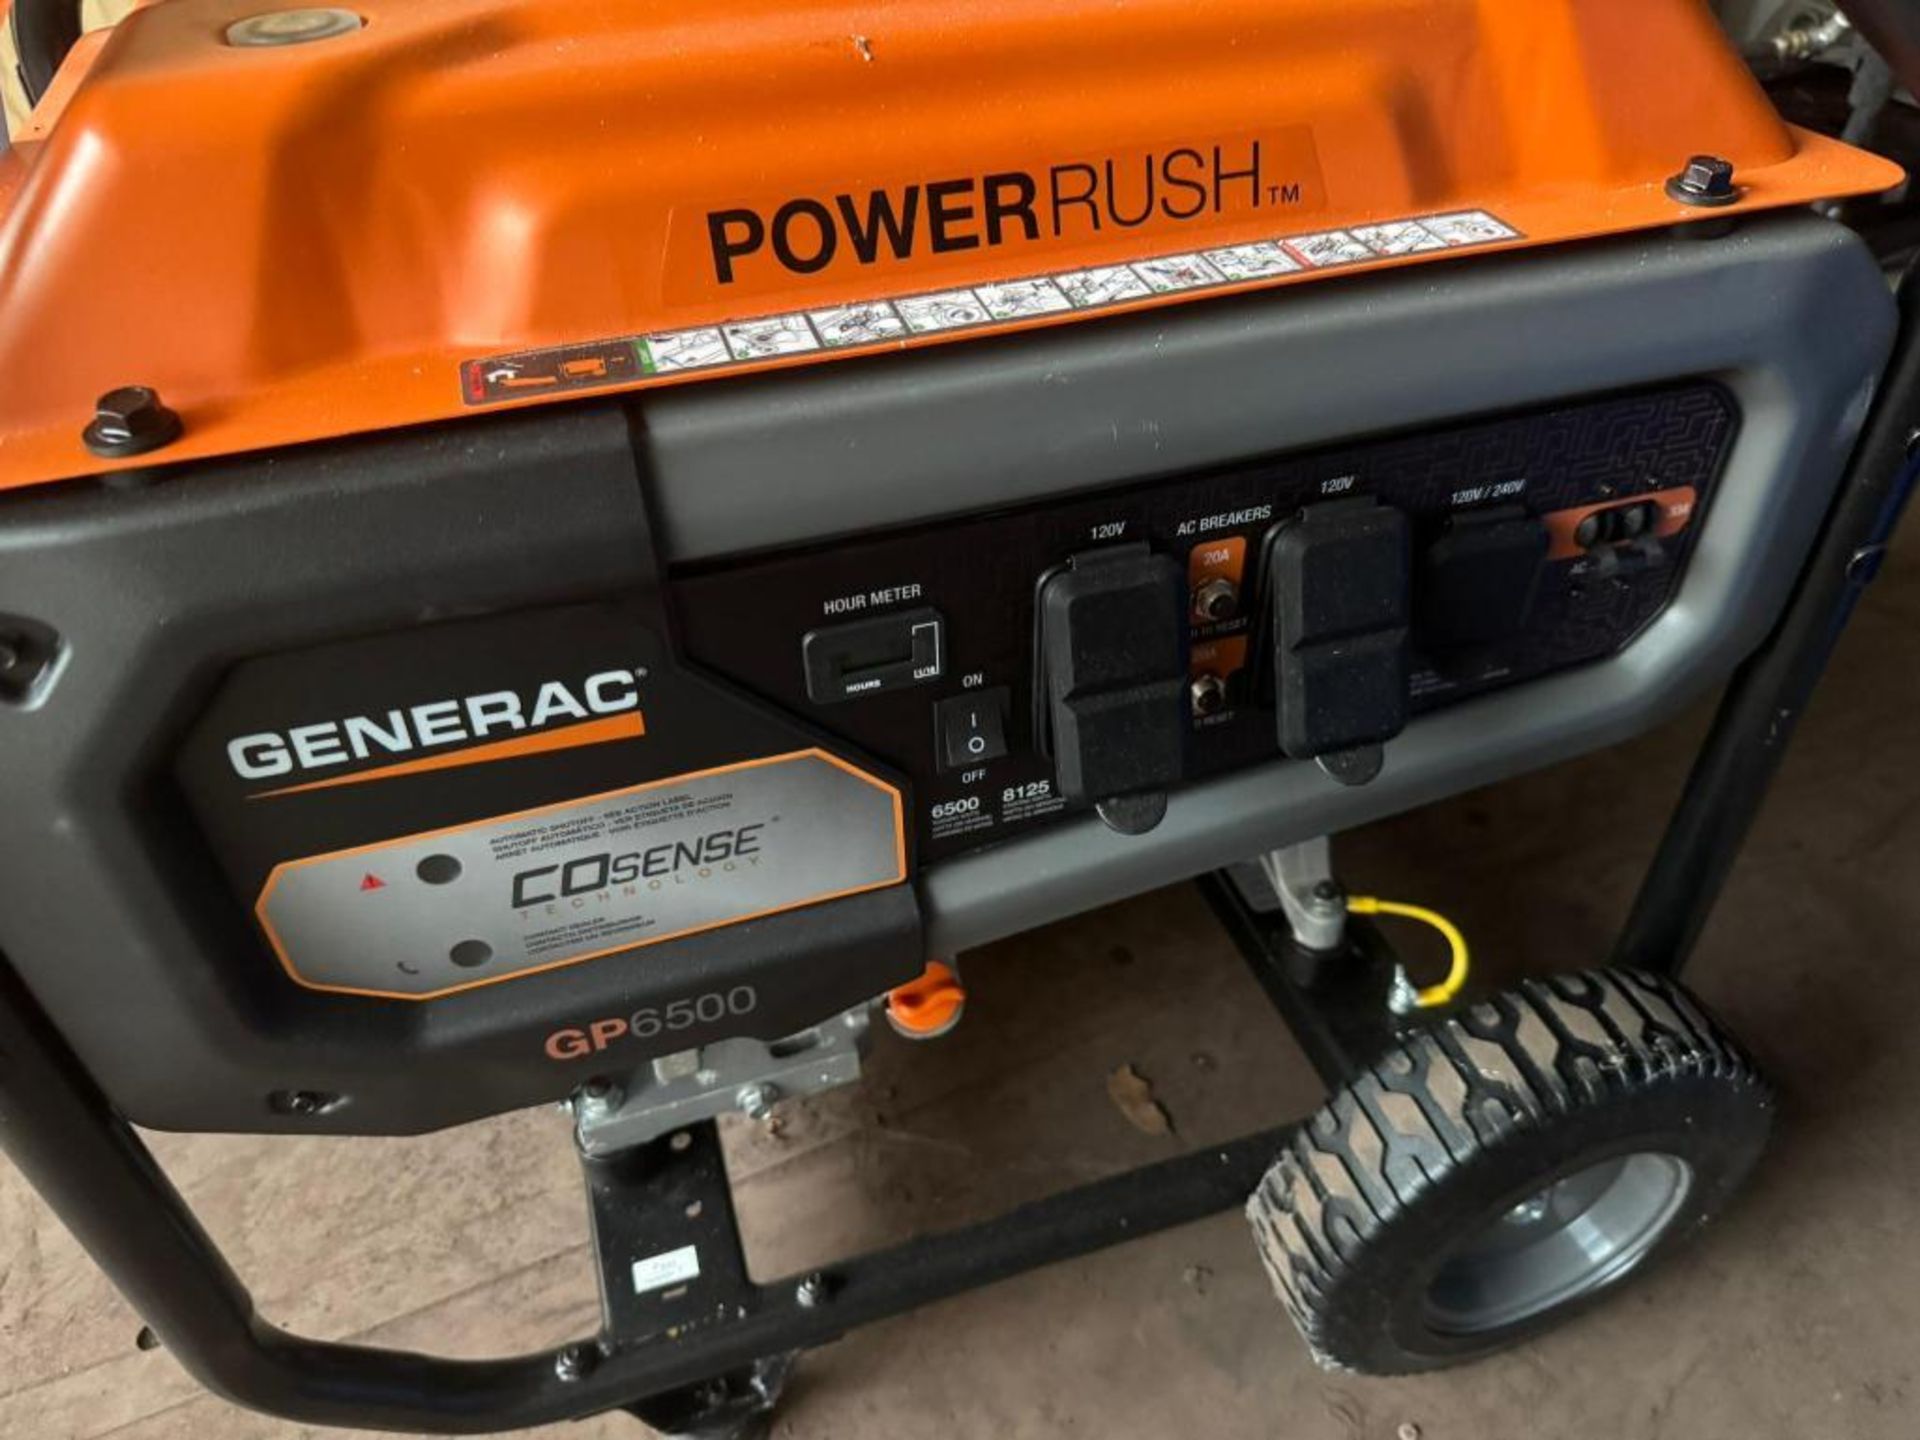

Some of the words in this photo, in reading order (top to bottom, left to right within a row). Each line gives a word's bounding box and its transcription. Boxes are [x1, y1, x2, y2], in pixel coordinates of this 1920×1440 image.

[1320, 475, 1354, 494] 120V
[1091, 521, 1126, 540] 120V
[1176, 519, 1196, 536] AC
[1200, 505, 1272, 532] BREAKERS
[1203, 549, 1230, 566] 20A
[823, 594, 867, 615] HOUR
[870, 583, 921, 606] METER
[846, 679, 882, 694] HOURS
[962, 673, 983, 688] ON
[227, 669, 639, 779] GENERAC
[962, 769, 986, 784] OFF
[1003, 780, 1050, 802] 8125
[931, 796, 980, 819] 6500
[519, 854, 763, 920] TECHNOLOGY
[544, 985, 758, 1061] GP6500
